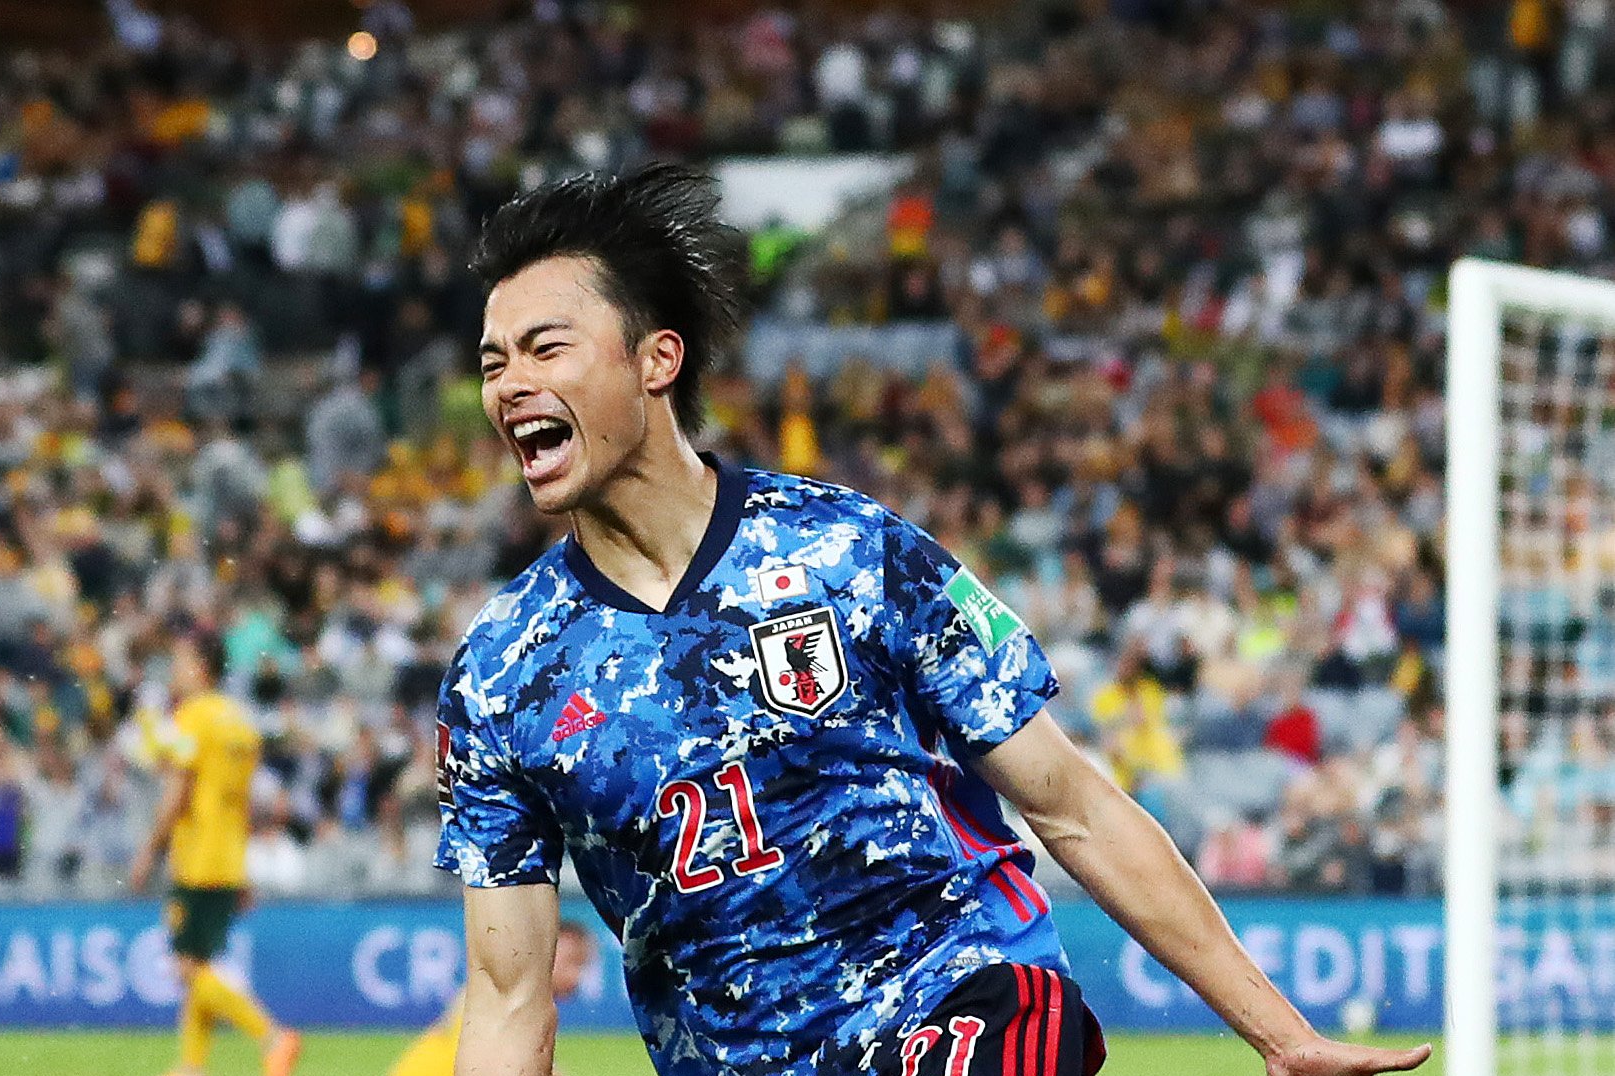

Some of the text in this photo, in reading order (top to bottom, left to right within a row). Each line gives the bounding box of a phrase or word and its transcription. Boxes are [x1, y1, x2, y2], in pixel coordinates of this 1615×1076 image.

[771, 616, 813, 633] JAPAN
[552, 711, 607, 742] adidas
[656, 760, 784, 893] 21
